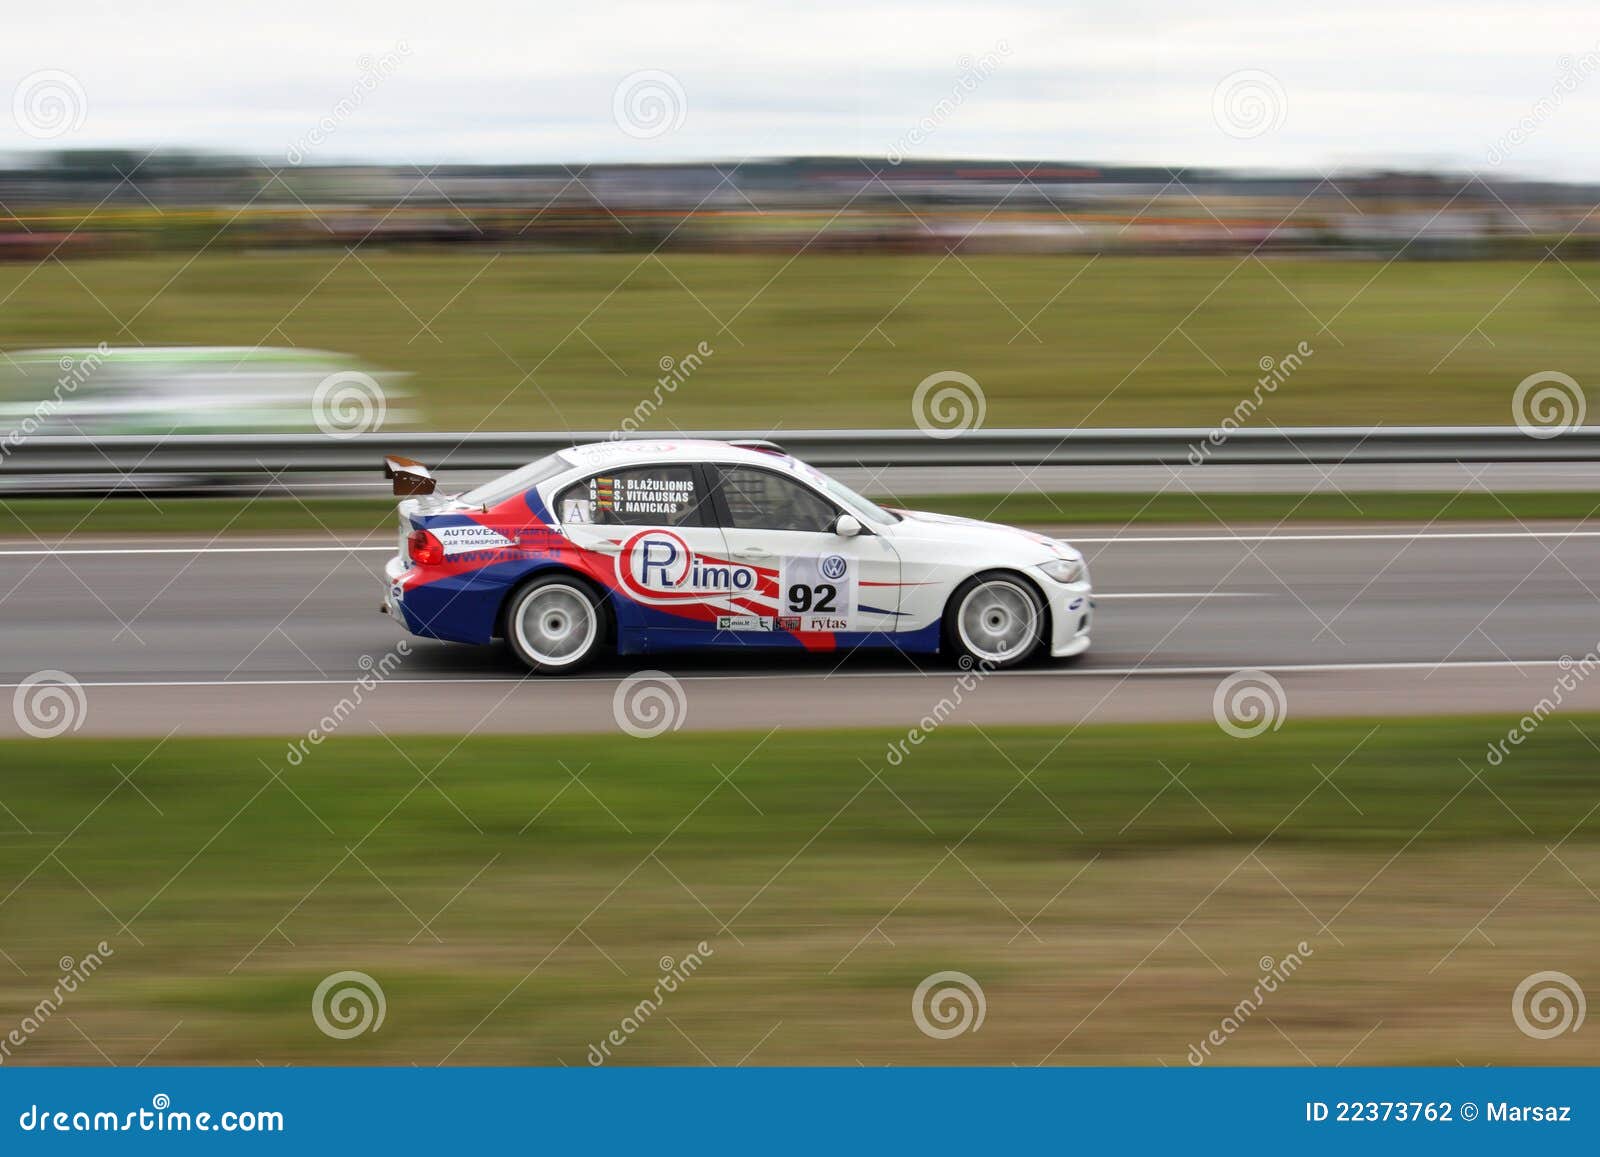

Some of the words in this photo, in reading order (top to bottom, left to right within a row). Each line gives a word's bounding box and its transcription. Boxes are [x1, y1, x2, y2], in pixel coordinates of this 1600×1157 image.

[590, 479, 597, 489] A
[614, 480, 624, 490] R.
[590, 489, 597, 500] B
[614, 490, 623, 500] S.
[626, 491, 689, 502] VITKAUSKAS
[614, 501, 623, 512] V.
[626, 502, 677, 513] NAVICKAS
[788, 584, 837, 613] 92
